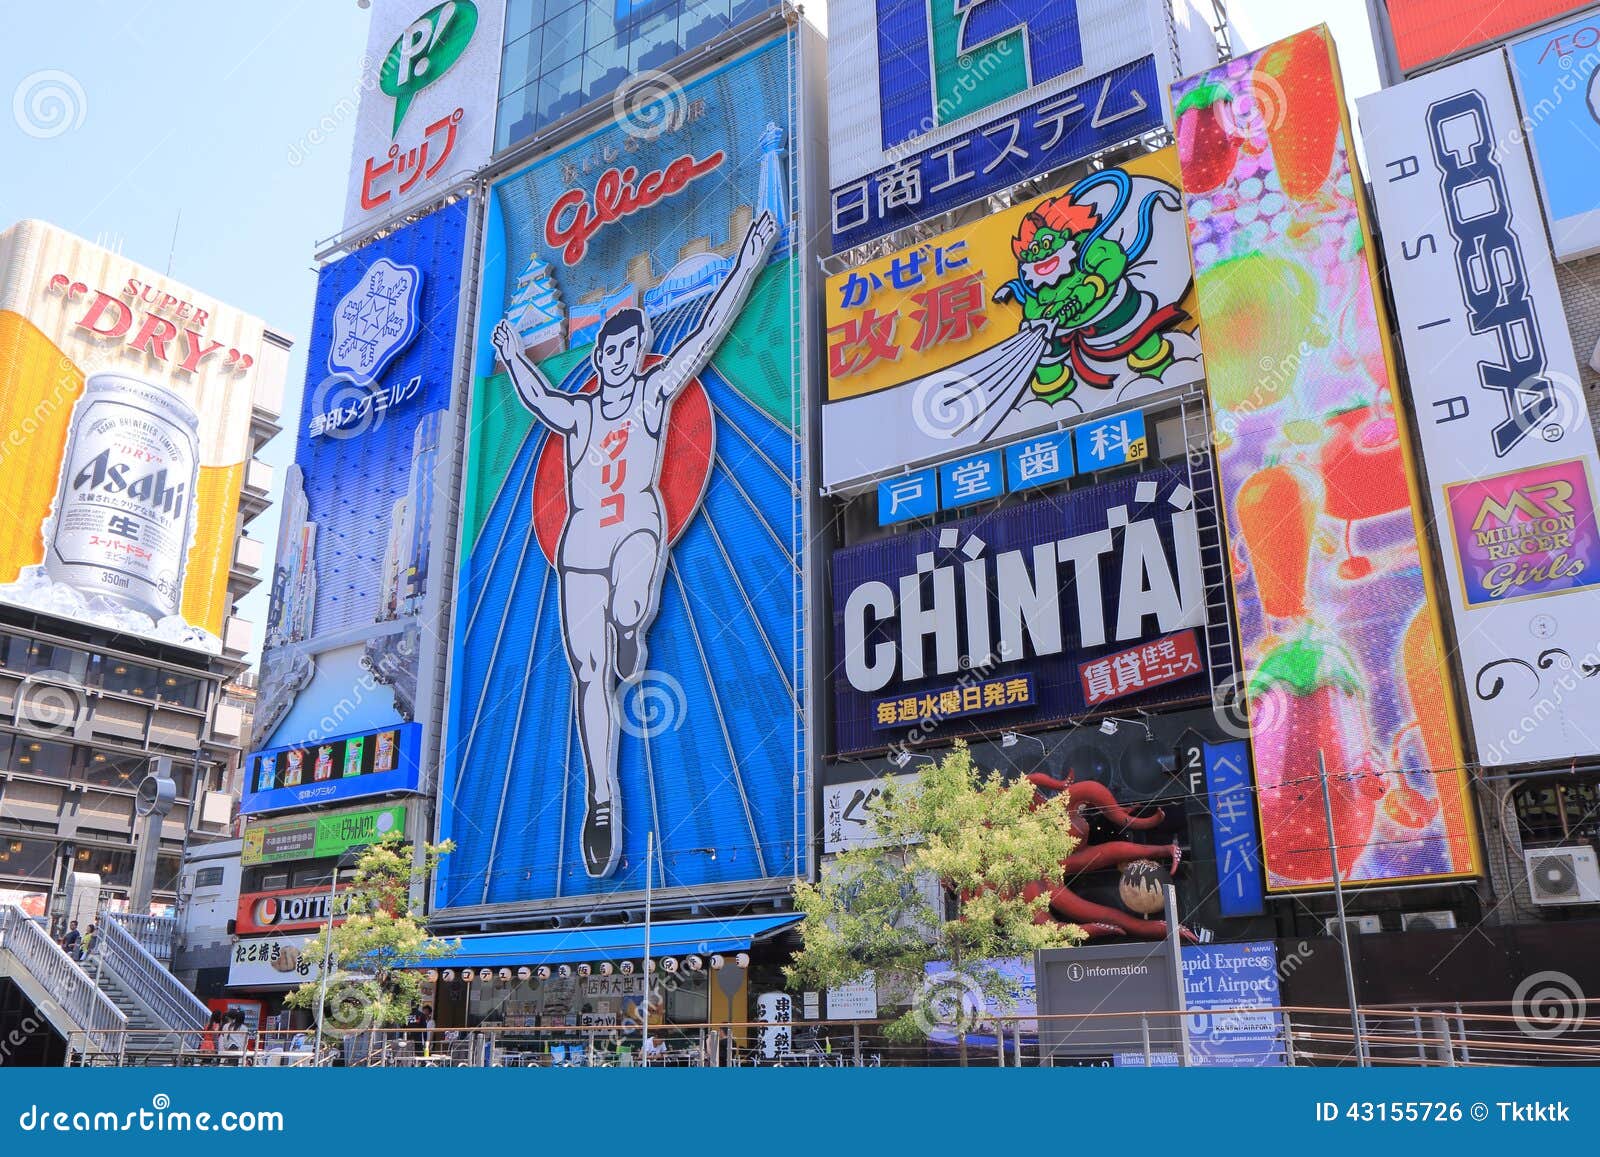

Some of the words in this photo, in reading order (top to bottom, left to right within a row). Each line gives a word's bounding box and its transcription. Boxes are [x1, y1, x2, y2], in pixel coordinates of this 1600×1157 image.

[360, 107, 464, 210] ピップ
[831, 77, 1147, 234] 日商エステム
[839, 240, 968, 309] かぜに
[123, 278, 210, 328] SUPER
[827, 270, 988, 378] 改源
[309, 375, 422, 439] 雪印メグミルク
[73, 448, 185, 521] Asahi
[600, 420, 630, 528] グリコ
[889, 419, 1131, 515] 戸堂歯科
[1130, 442, 1145, 459] 3F
[89, 535, 153, 561] スーパードライ
[108, 515, 140, 541] 生
[1476, 514, 1576, 548] MILLION
[1487, 532, 1573, 561] RACER
[101, 571, 130, 589] 350ml
[1481, 553, 1585, 598] Girls
[1083, 651, 1145, 701] 賃貸
[1142, 641, 1176, 666] 住宅
[1146, 653, 1199, 682] ニュース
[876, 677, 1029, 725] 毎週水曜日発売
[1212, 754, 1253, 898] ペンギンバー
[1086, 964, 1148, 977] information
[1181, 953, 1211, 976] apid
[1214, 953, 1268, 974] Express
[1217, 976, 1272, 997] Airport
